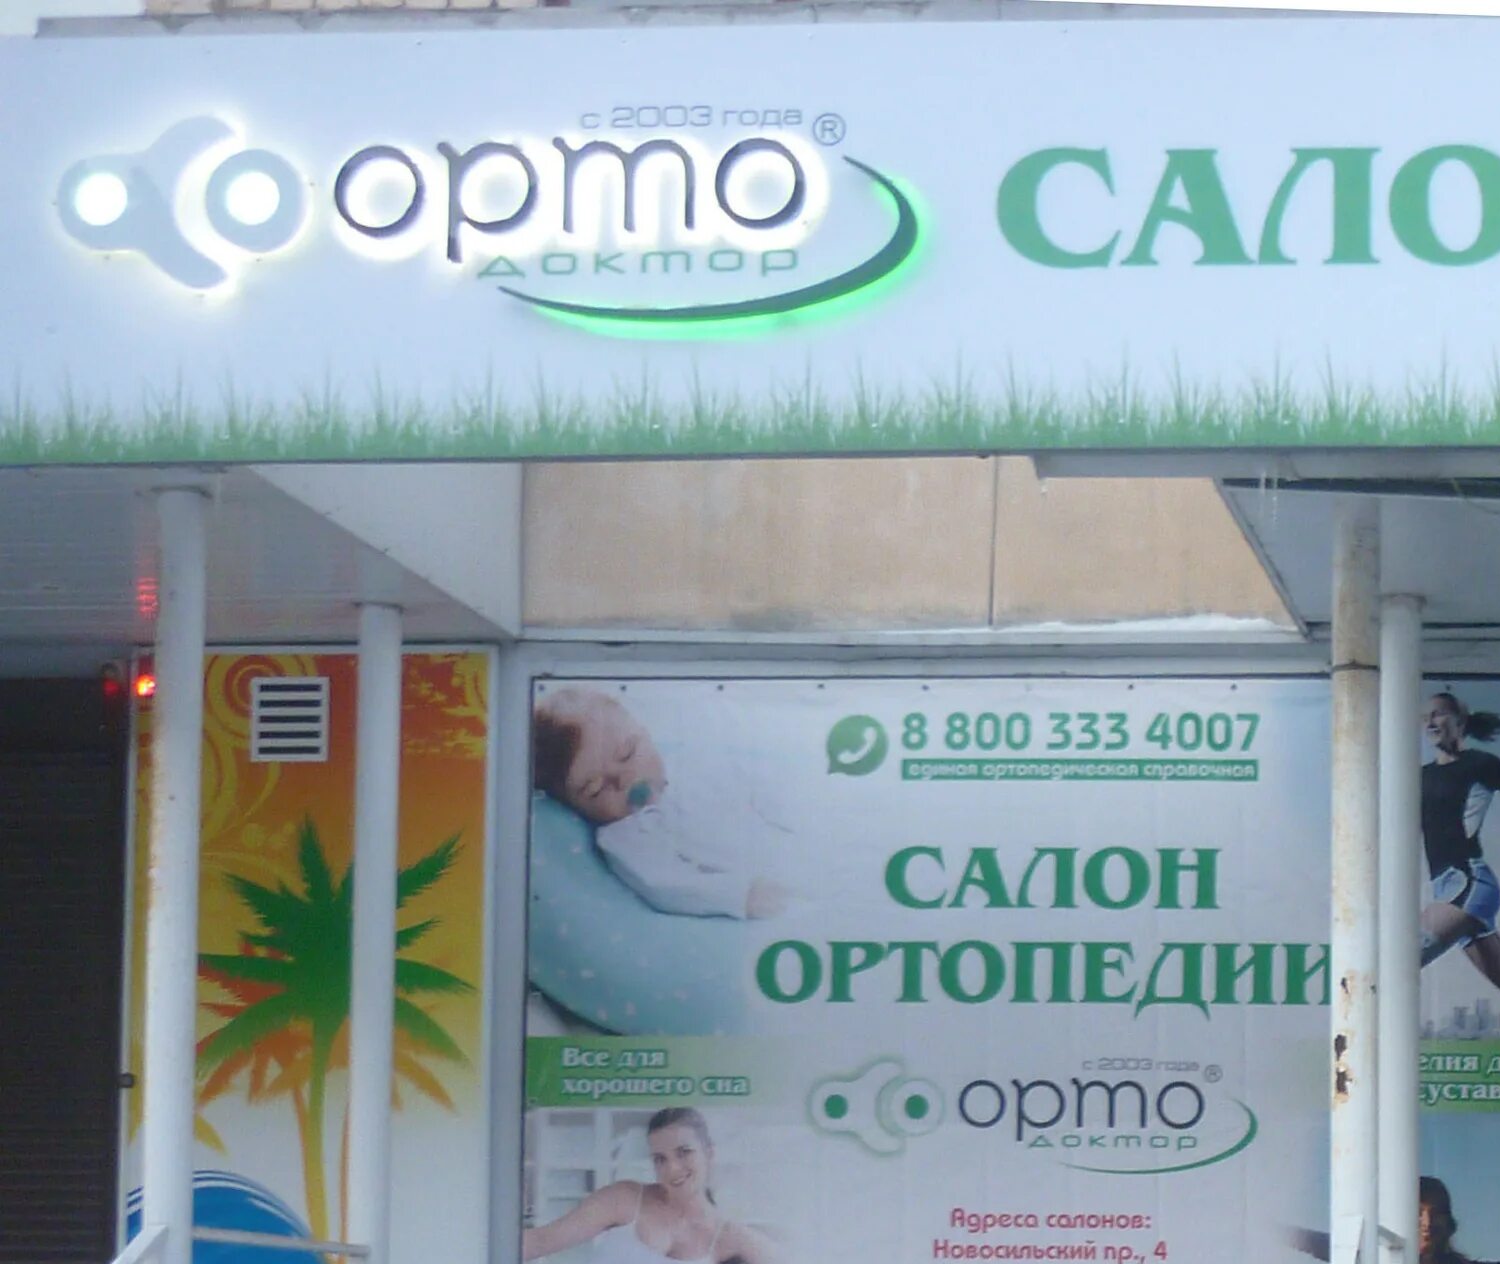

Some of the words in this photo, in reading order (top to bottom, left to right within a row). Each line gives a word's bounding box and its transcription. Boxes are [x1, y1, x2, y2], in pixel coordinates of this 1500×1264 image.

[579, 112, 601, 131] с
[611, 105, 713, 129] 2003
[720, 106, 804, 132] года
[901, 713, 928, 751] 8
[944, 712, 1031, 751] 800
[1046, 712, 1130, 751] 333
[1145, 712, 1260, 751] 4007
[908, 763, 977, 781] единая
[983, 763, 1139, 781] ортопедическая
[1143, 763, 1255, 781] справочная
[884, 846, 1221, 909] САЛОН
[755, 940, 1331, 1021] ОРТОПЕДИИ
[562, 1047, 610, 1068] Все
[615, 1049, 667, 1072] для
[1098, 1058, 1153, 1070] 2003
[560, 1075, 694, 1100] хорошего
[702, 1077, 750, 1096] сна
[950, 1208, 1039, 1233] Адреса
[1045, 1213, 1152, 1229] салонов:
[932, 1239, 1096, 1260] Новосильский
[1103, 1246, 1146, 1264] пр.,
[1153, 1241, 1168, 1260] 4
